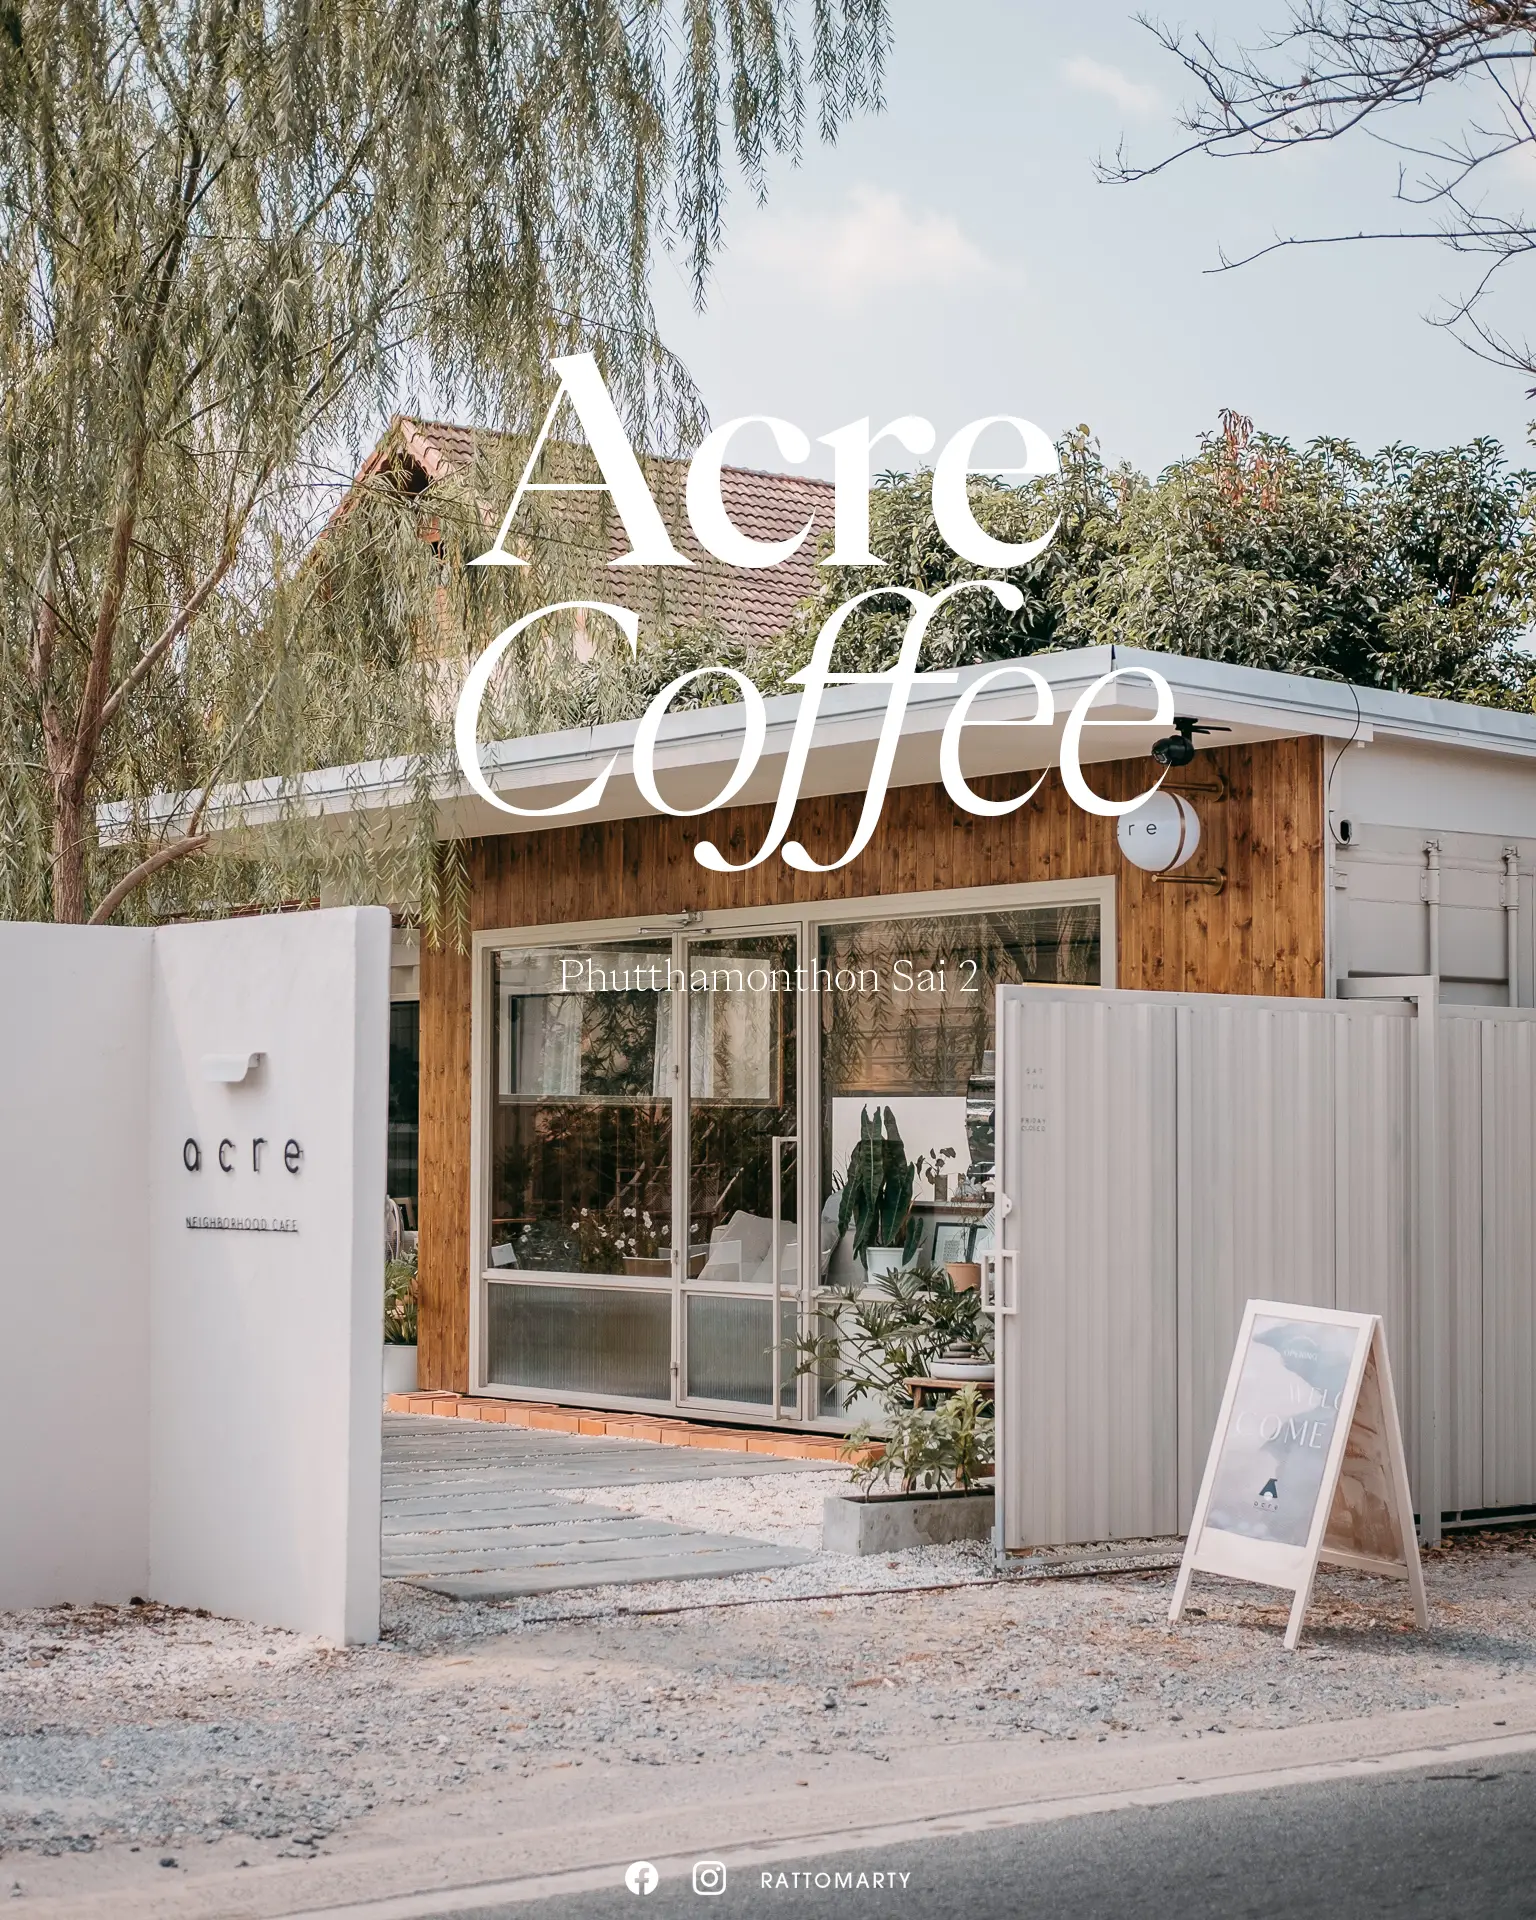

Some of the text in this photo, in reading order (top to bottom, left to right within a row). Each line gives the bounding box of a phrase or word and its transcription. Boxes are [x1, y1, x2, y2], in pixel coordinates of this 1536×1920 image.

[1117, 823, 1157, 837] re
[183, 1137, 302, 1174] acre
[186, 1216, 298, 1231] NEIGHBORHOOD CAFE
[1235, 1410, 1327, 1449] COME
